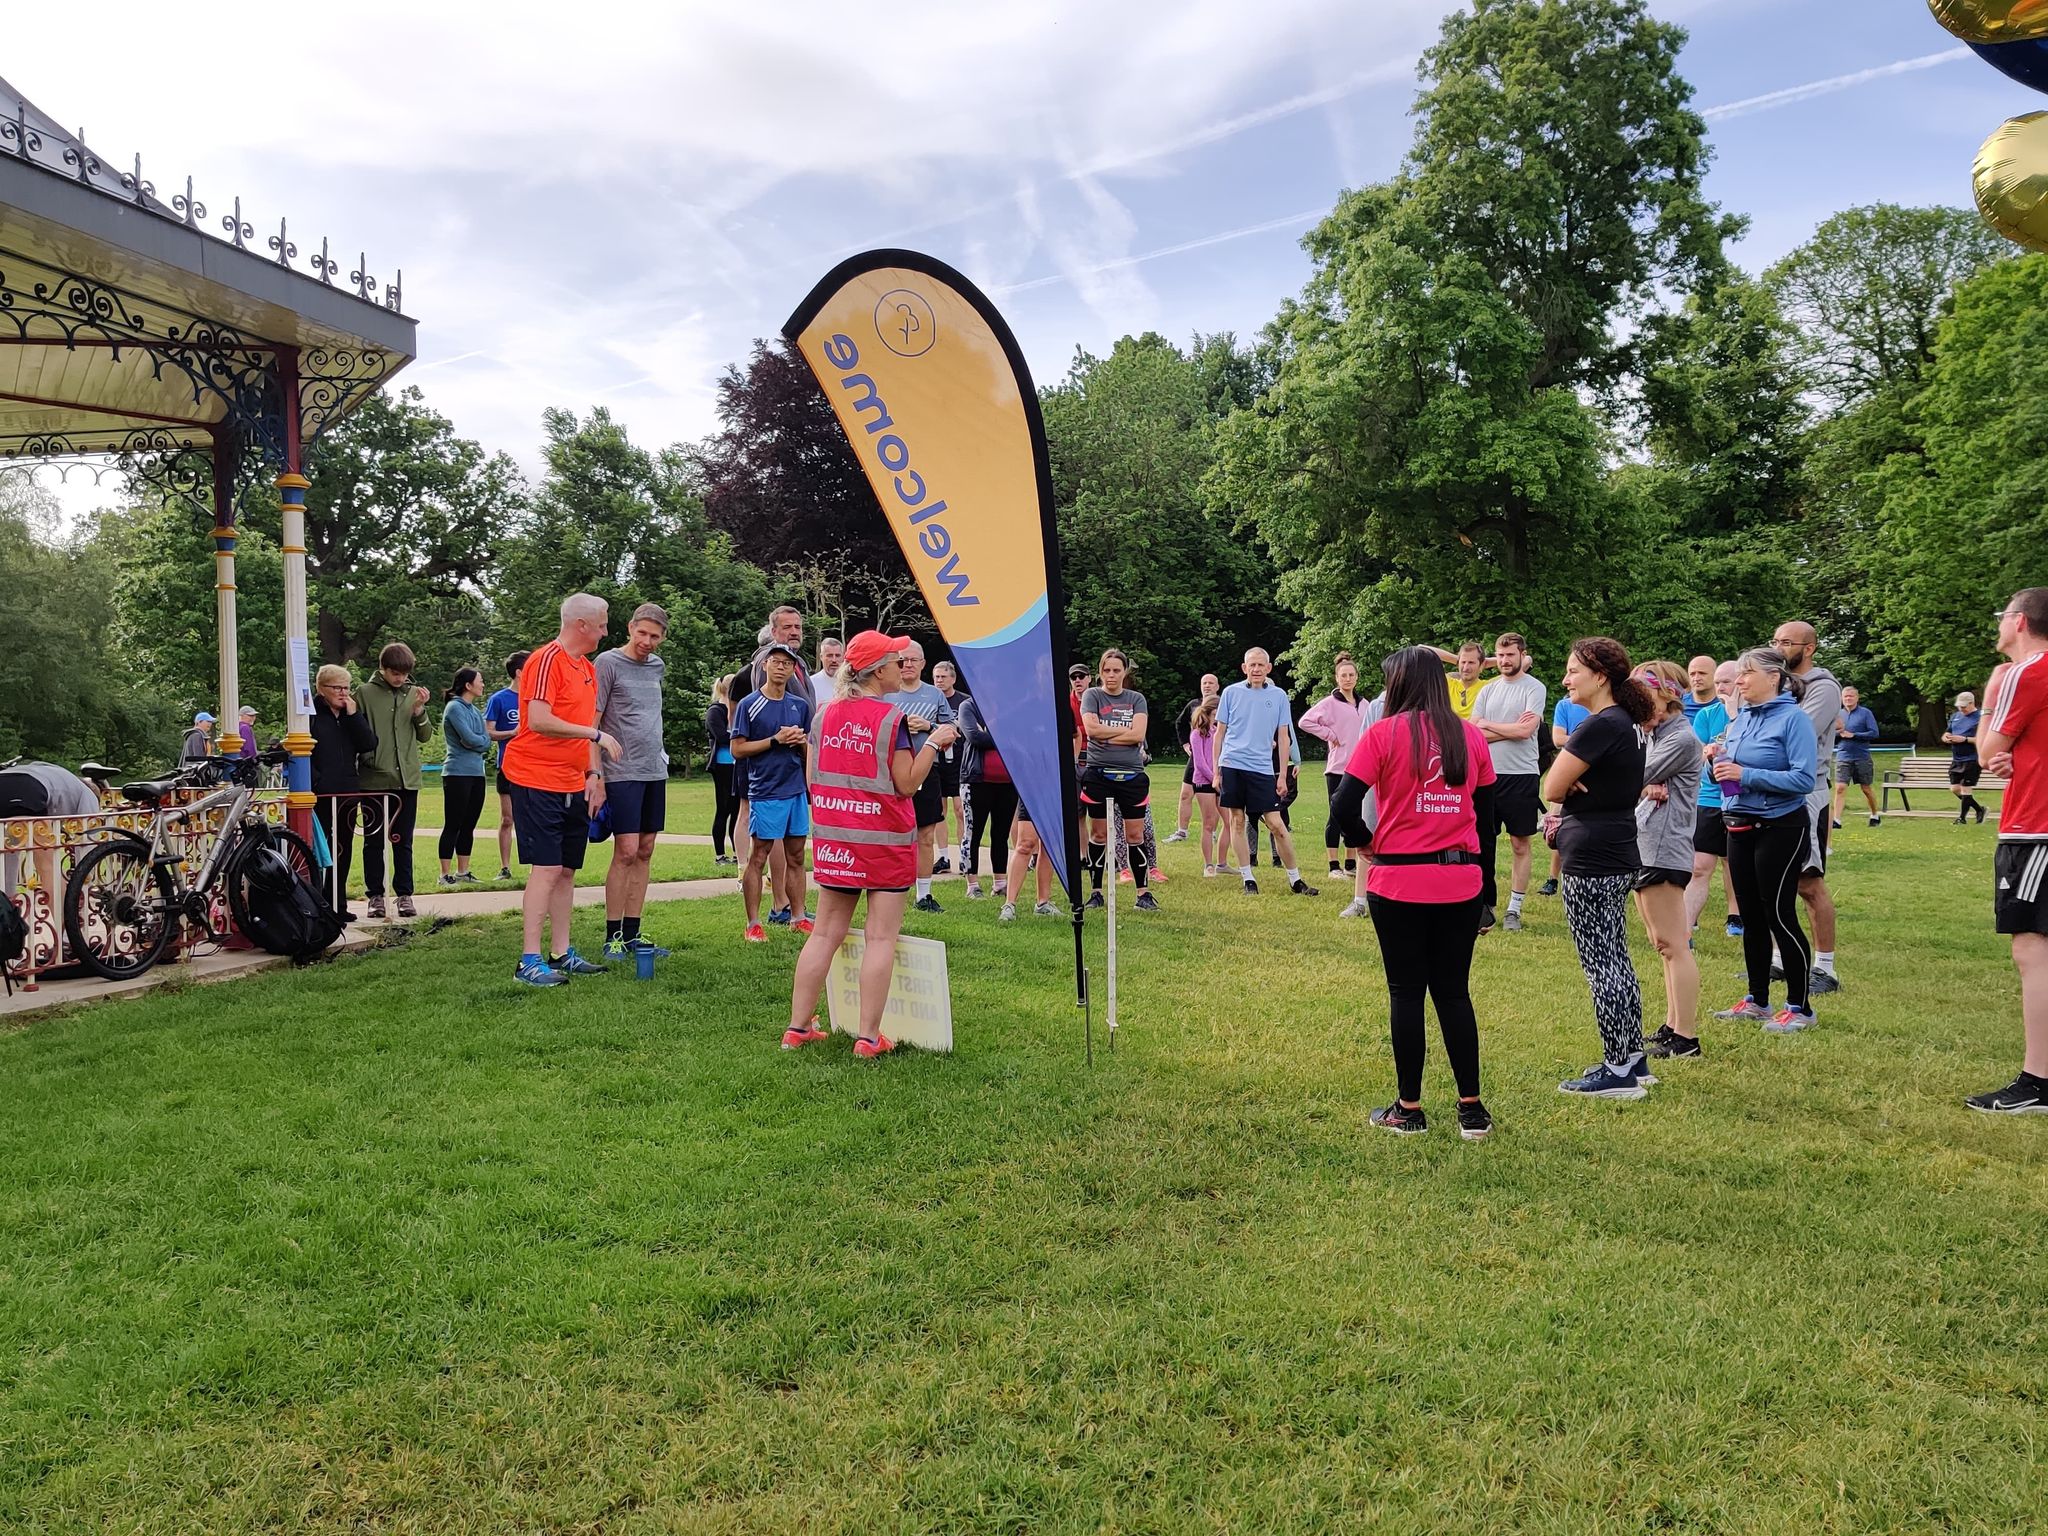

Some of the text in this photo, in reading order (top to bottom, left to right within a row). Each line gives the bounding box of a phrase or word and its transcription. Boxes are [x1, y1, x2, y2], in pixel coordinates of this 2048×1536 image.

[822, 731, 873, 755] parkrun
[1423, 791, 1462, 804] Running
[1423, 803, 1461, 814] Sisters
[816, 843, 855, 870] Vitality
